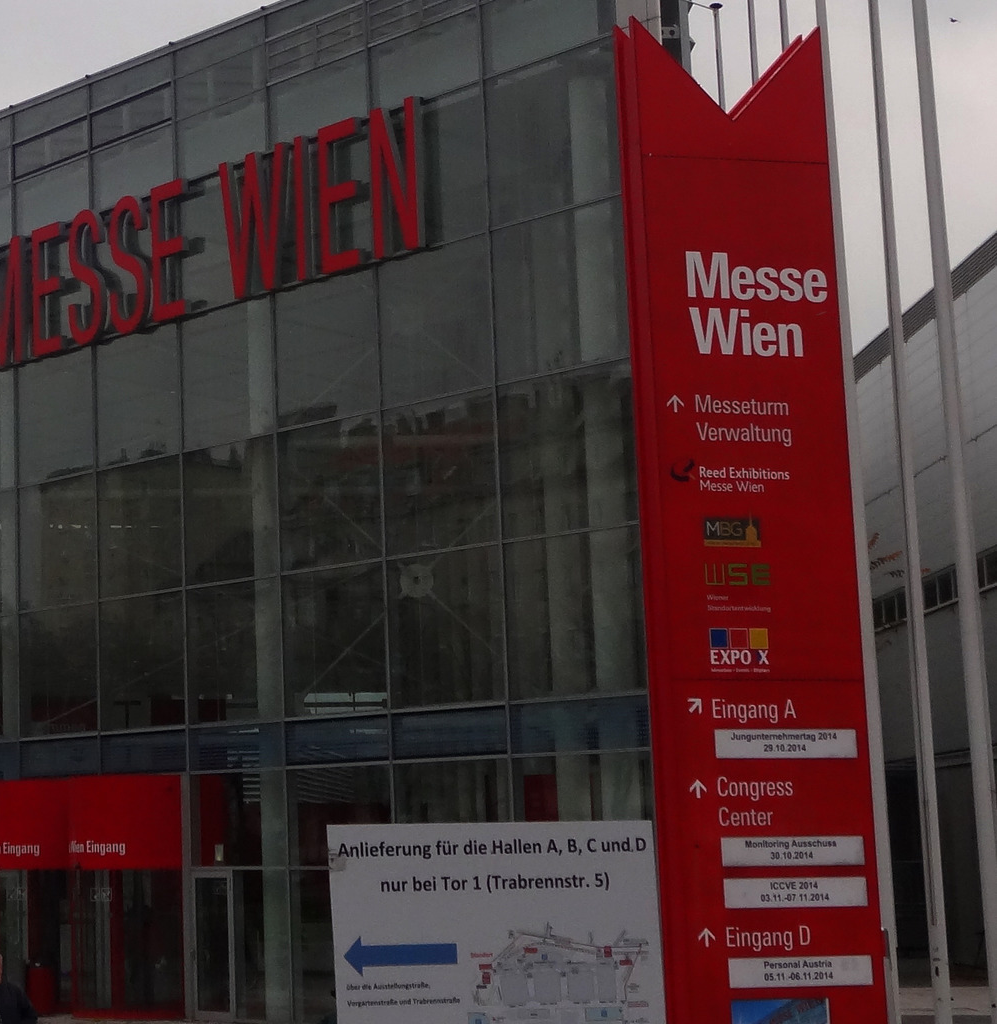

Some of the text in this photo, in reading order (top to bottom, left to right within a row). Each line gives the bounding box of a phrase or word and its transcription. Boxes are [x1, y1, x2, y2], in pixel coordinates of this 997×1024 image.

[219, 96, 425, 300] WIEN
[685, 251, 828, 303] Messe
[689, 307, 804, 357] Wien
[695, 394, 789, 416] Messeturm
[696, 422, 792, 447] Verwaltung
[699, 466, 790, 480] Reed Exhibitions
[699, 480, 765, 493] Messe Wien
[706, 521, 743, 537] MBG
[704, 563, 771, 586] WSE
[710, 649, 770, 665] EXPO X
[711, 698, 797, 724] Eingang A
[730, 732, 837, 742] Jungunternehmertag 2014
[763, 744, 807, 752] 29.10.2014
[716, 776, 794, 801] Congress
[718, 807, 773, 827] Center
[3, 842, 40, 856] Eingang
[86, 840, 126, 855] Eingang
[338, 837, 647, 859] Anlieferung für die Hallen A, B, C und D
[745, 839, 837, 850] Monitoring Ausschuss
[770, 851, 813, 860] 30.10.2014
[380, 872, 610, 893] nur bei Tor 1 (Trabrennstr. 5)
[770, 881, 818, 890] ICCVE 2014
[725, 925, 811, 952] Eingang D
[763, 960, 833, 969] Personal Austria
